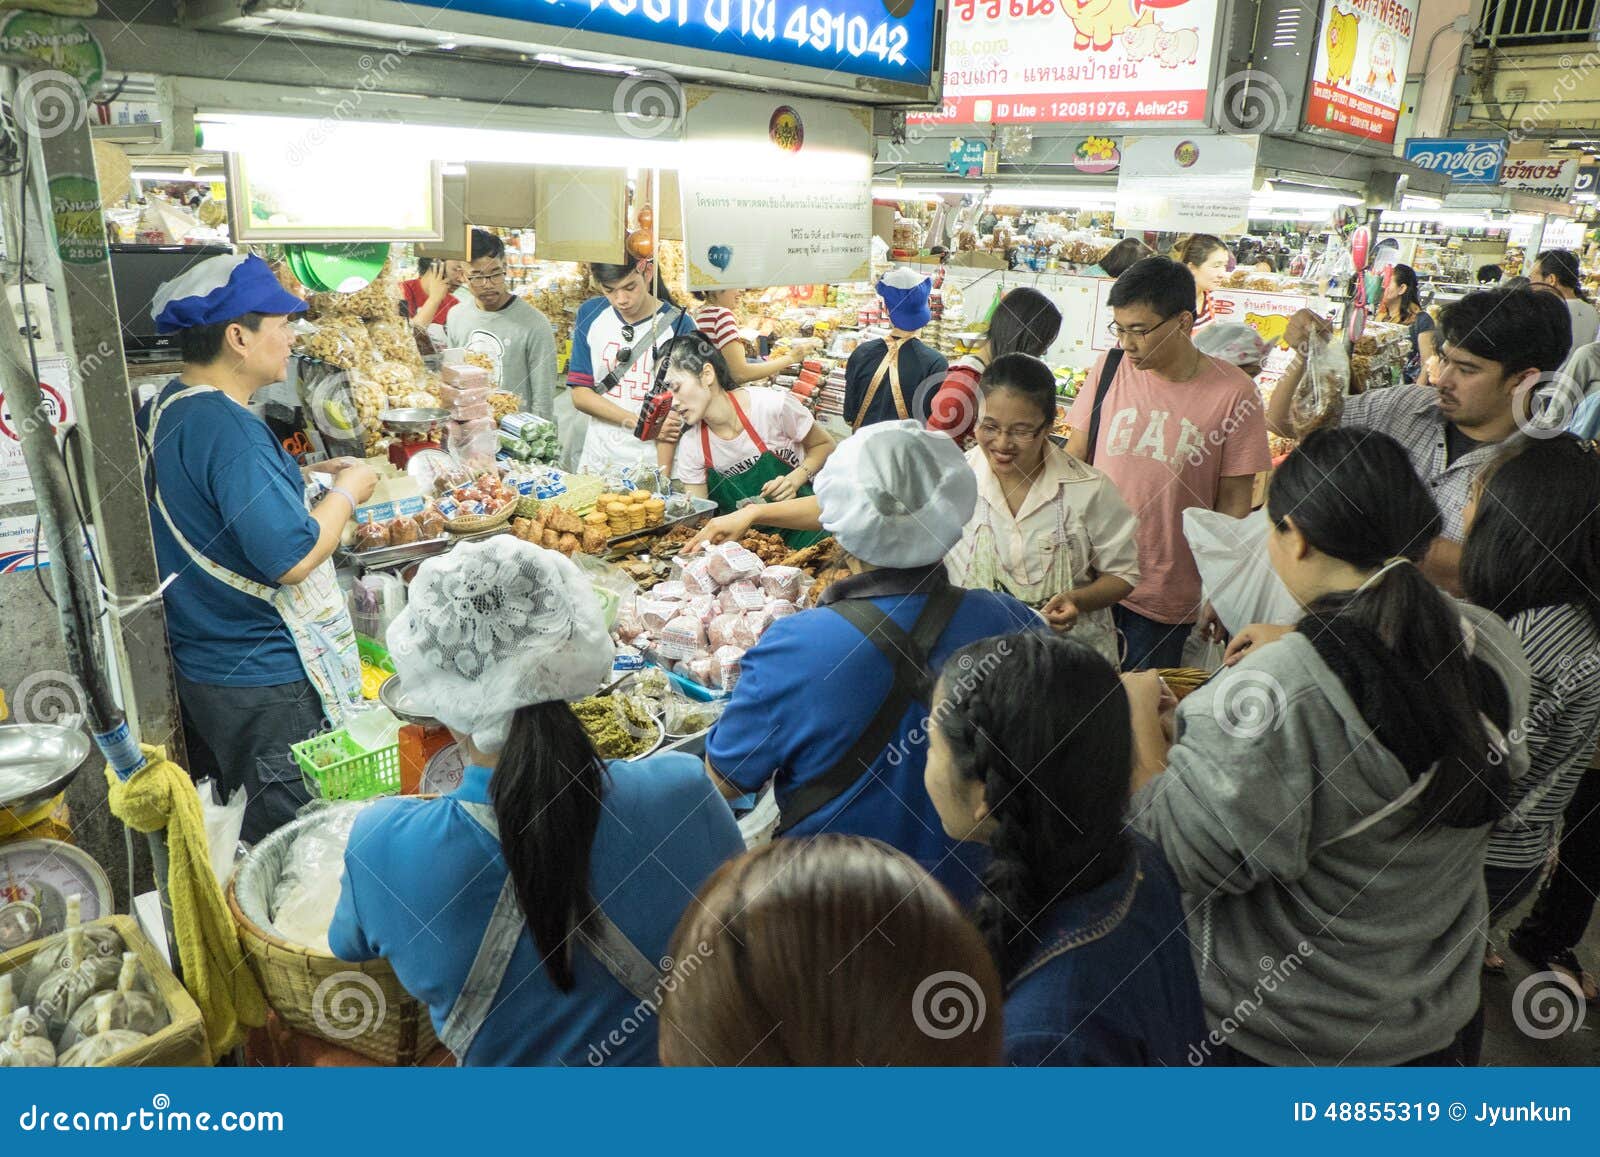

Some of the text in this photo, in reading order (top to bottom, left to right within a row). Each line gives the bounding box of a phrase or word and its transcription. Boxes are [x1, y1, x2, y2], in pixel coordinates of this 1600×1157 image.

[783, 5, 908, 65] 491042
[997, 104, 1009, 117] ID
[1013, 103, 1037, 117] Line
[1050, 101, 1130, 118] 12081976,
